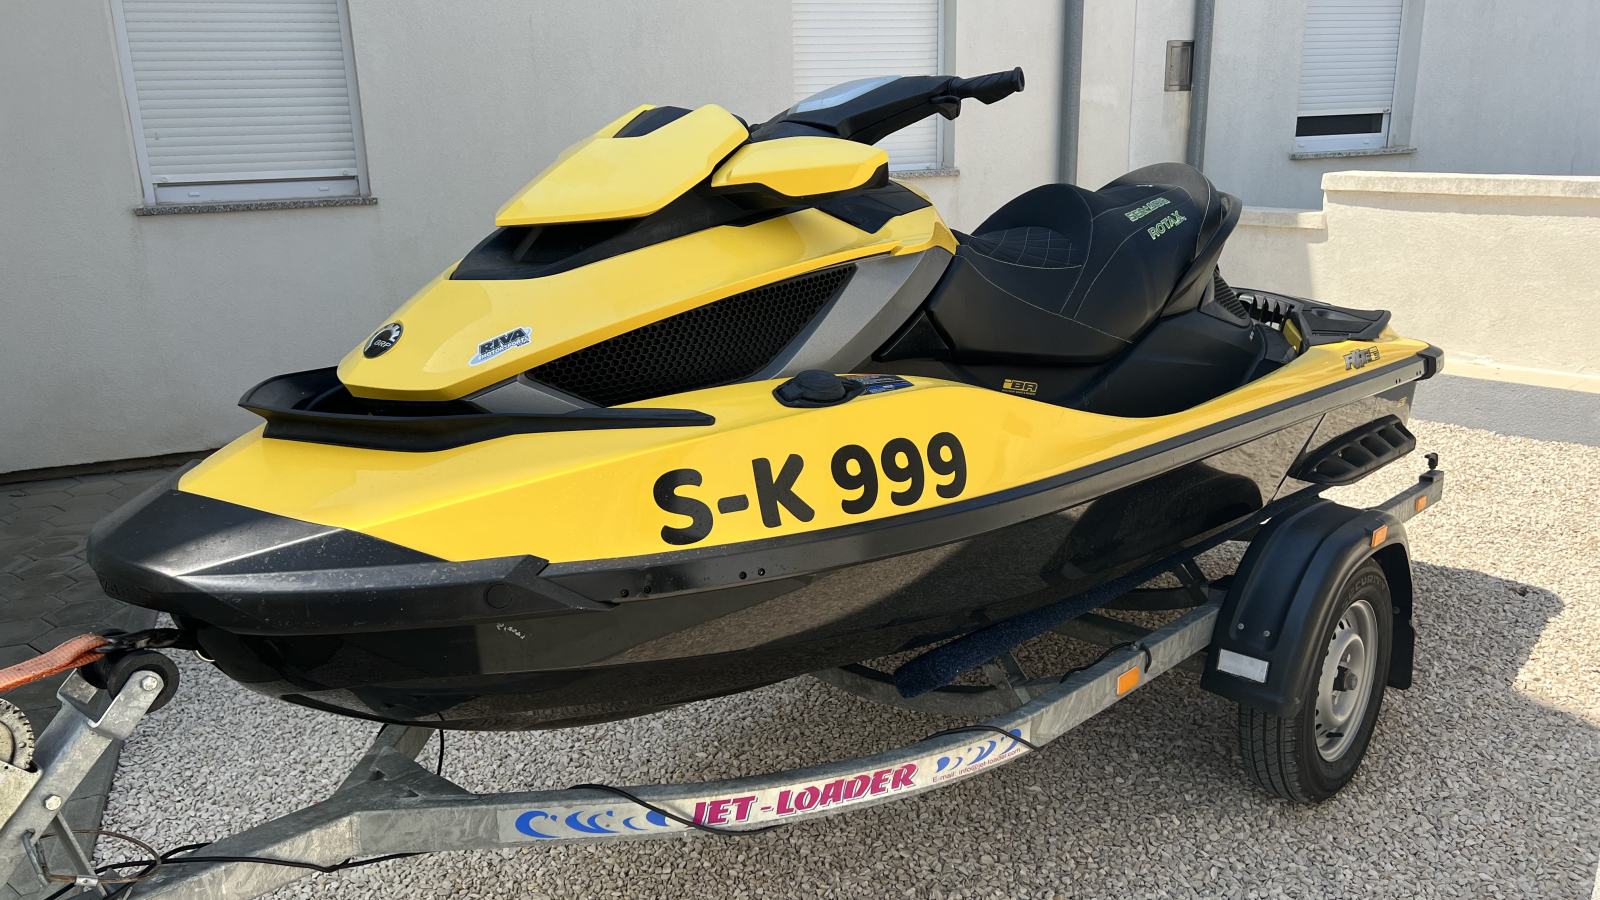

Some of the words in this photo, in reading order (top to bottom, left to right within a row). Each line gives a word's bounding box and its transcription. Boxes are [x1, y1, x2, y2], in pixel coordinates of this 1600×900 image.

[1147, 210, 1185, 240] ROTAX
[374, 339, 391, 348] BRP
[479, 327, 526, 354] RIVA
[653, 453, 815, 546] S-K
[830, 431, 968, 515] 999
